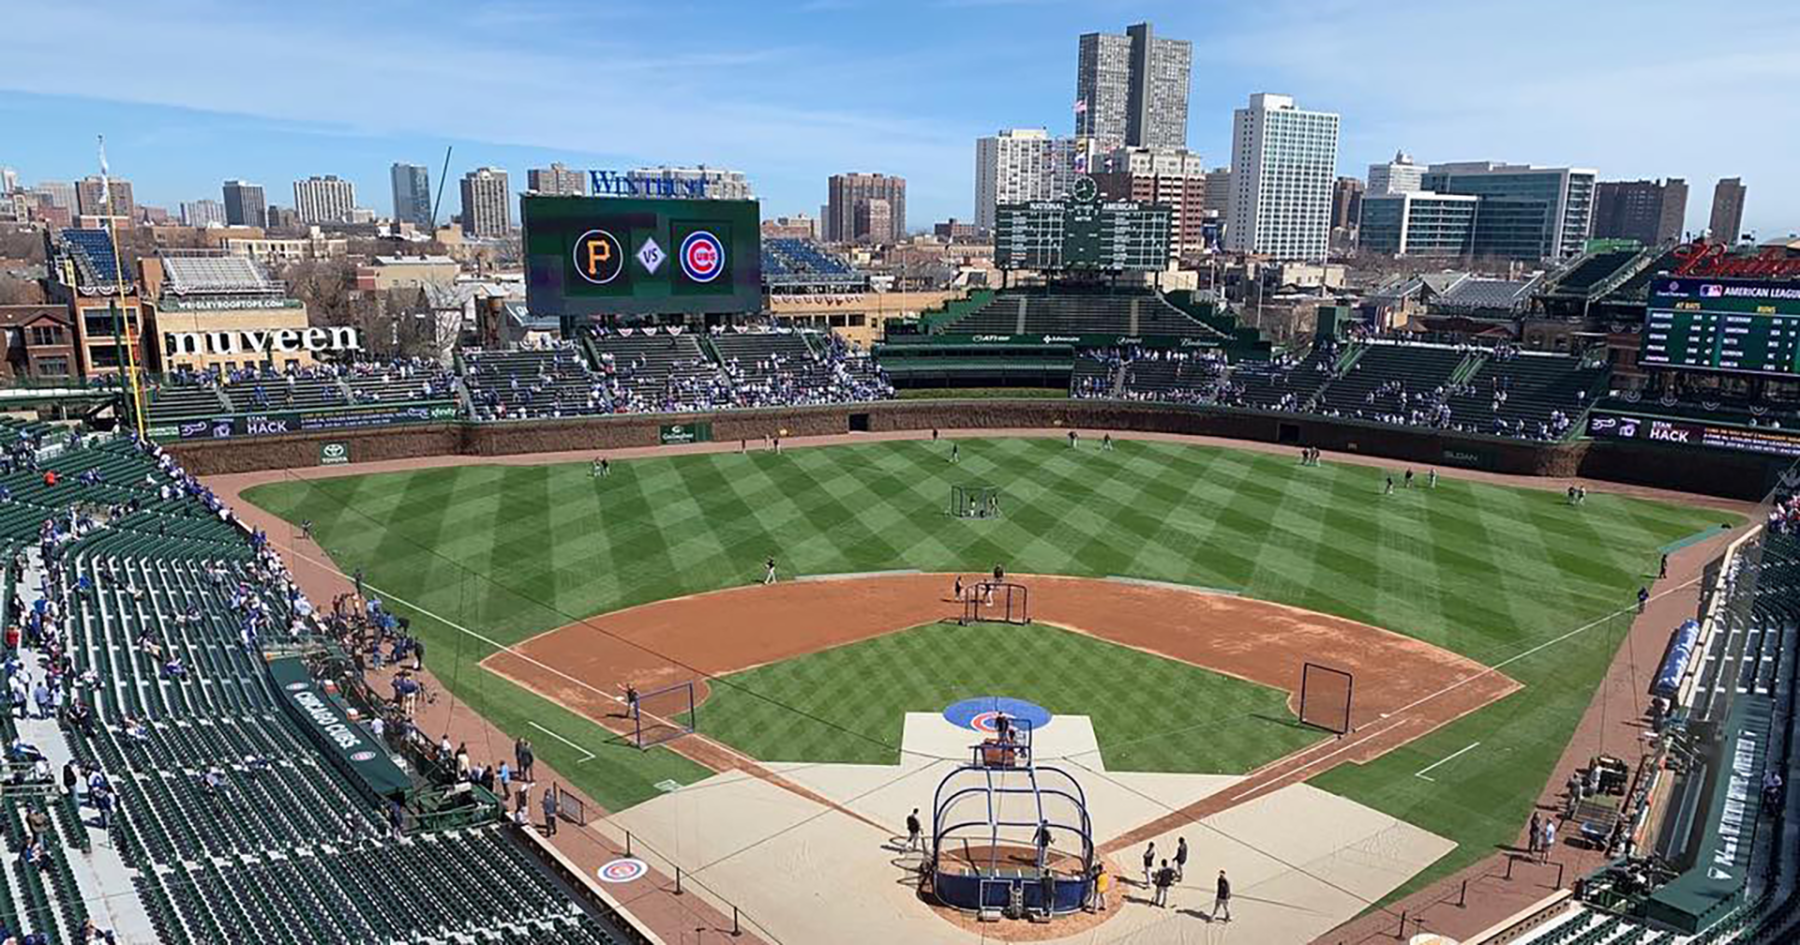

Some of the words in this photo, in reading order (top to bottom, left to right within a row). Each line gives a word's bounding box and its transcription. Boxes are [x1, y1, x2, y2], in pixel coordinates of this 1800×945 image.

[588, 170, 710, 198] WINTRUST
[1029, 202, 1065, 211] NATIONAL
[1102, 202, 1139, 211] AMERICAN
[586, 240, 611, 275] P
[643, 247, 659, 264] VS
[1723, 286, 1769, 298] AMERICAN
[1770, 288, 1800, 299] LEAGU
[165, 326, 366, 355] nuveen
[430, 406, 457, 418] xfinity
[247, 421, 288, 434] HACK
[1652, 421, 1672, 430] STAN
[1649, 429, 1690, 443] HACK
[293, 691, 339, 725] CHICAGO
[324, 723, 361, 750] CUBS
